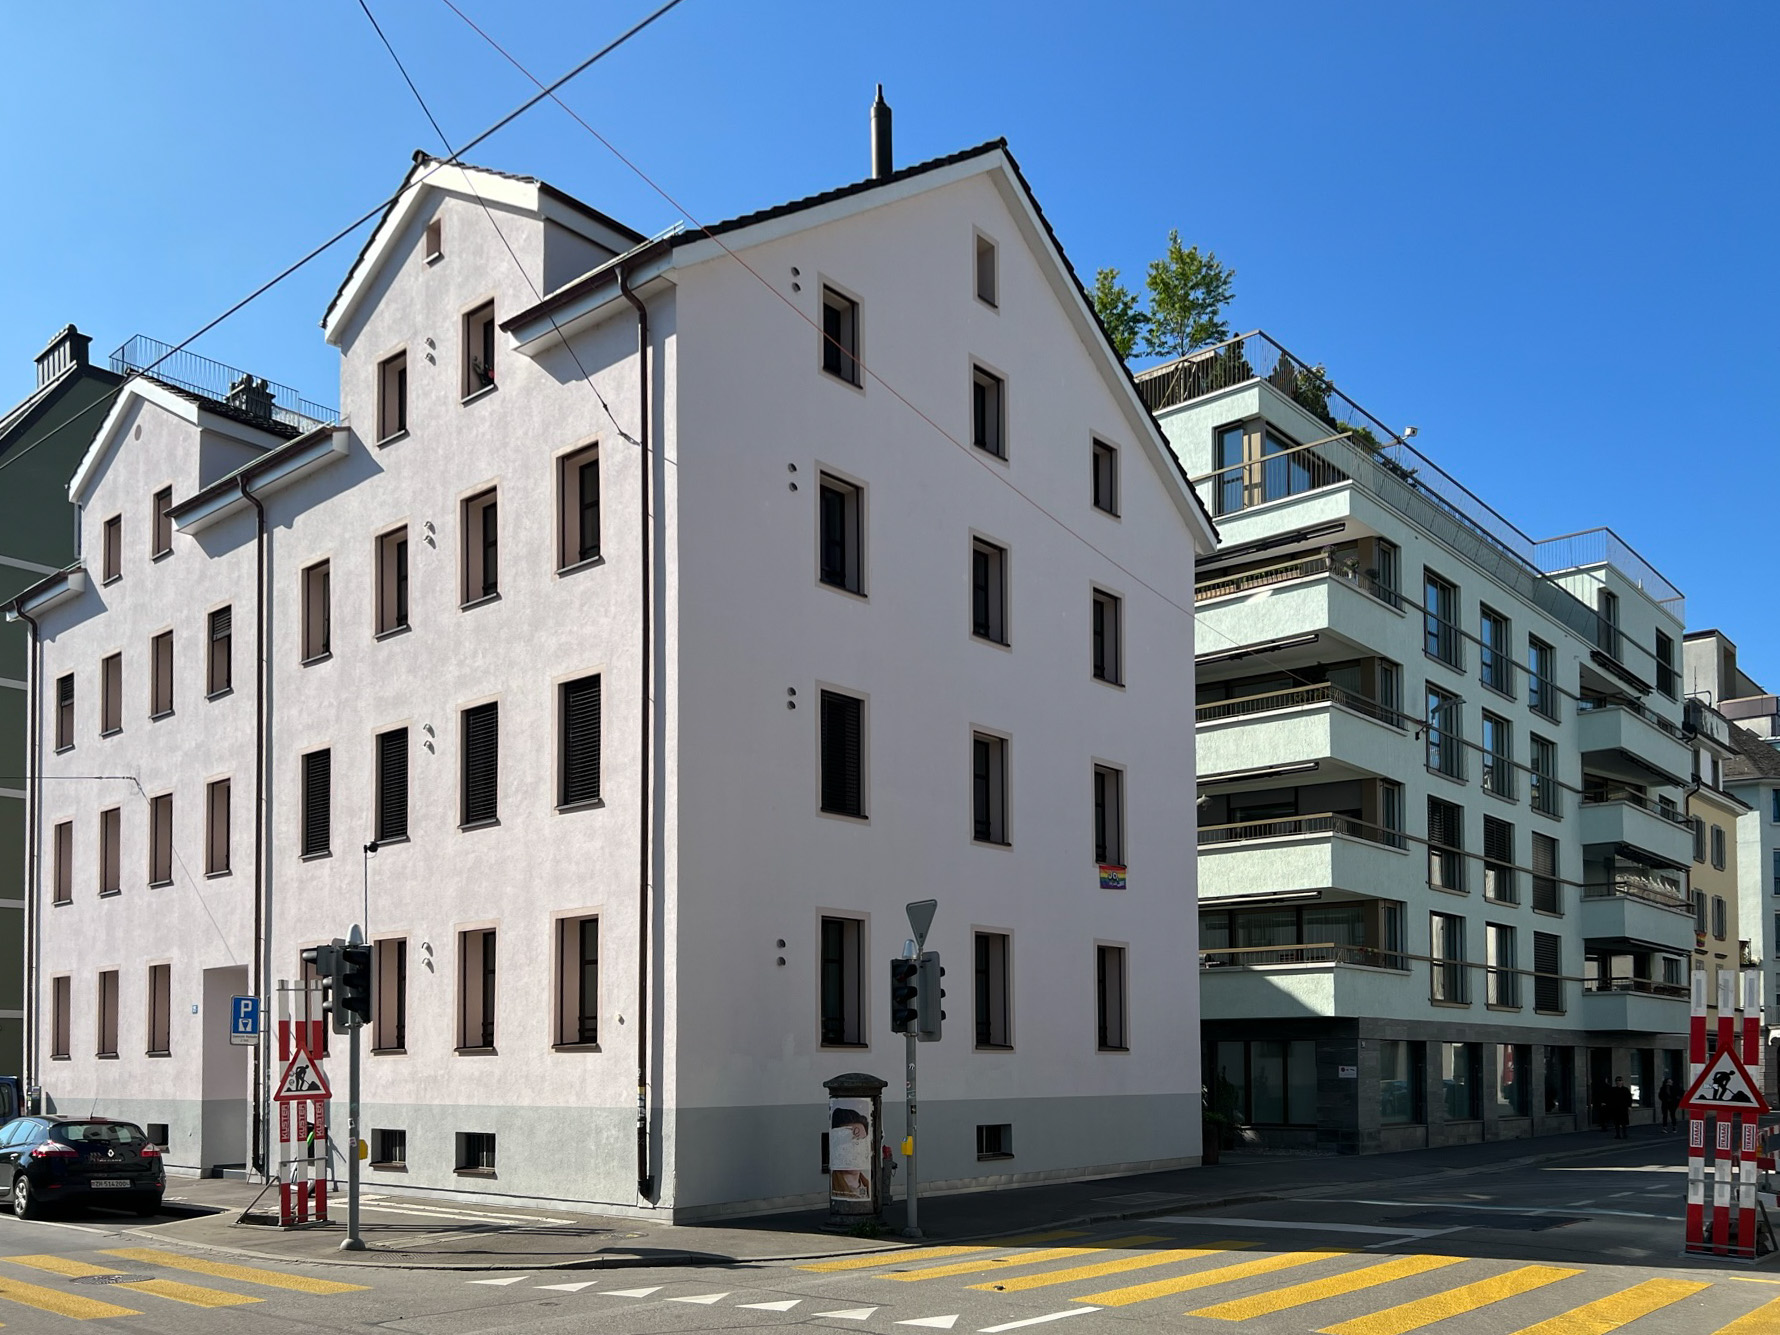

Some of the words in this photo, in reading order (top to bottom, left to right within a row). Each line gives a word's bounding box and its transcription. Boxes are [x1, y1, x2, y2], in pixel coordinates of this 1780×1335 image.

[240, 1000, 252, 1018] P
[281, 1104, 289, 1140] KUSTER
[298, 1103, 306, 1139] KUSTER
[315, 1102, 323, 1137] KUSTER
